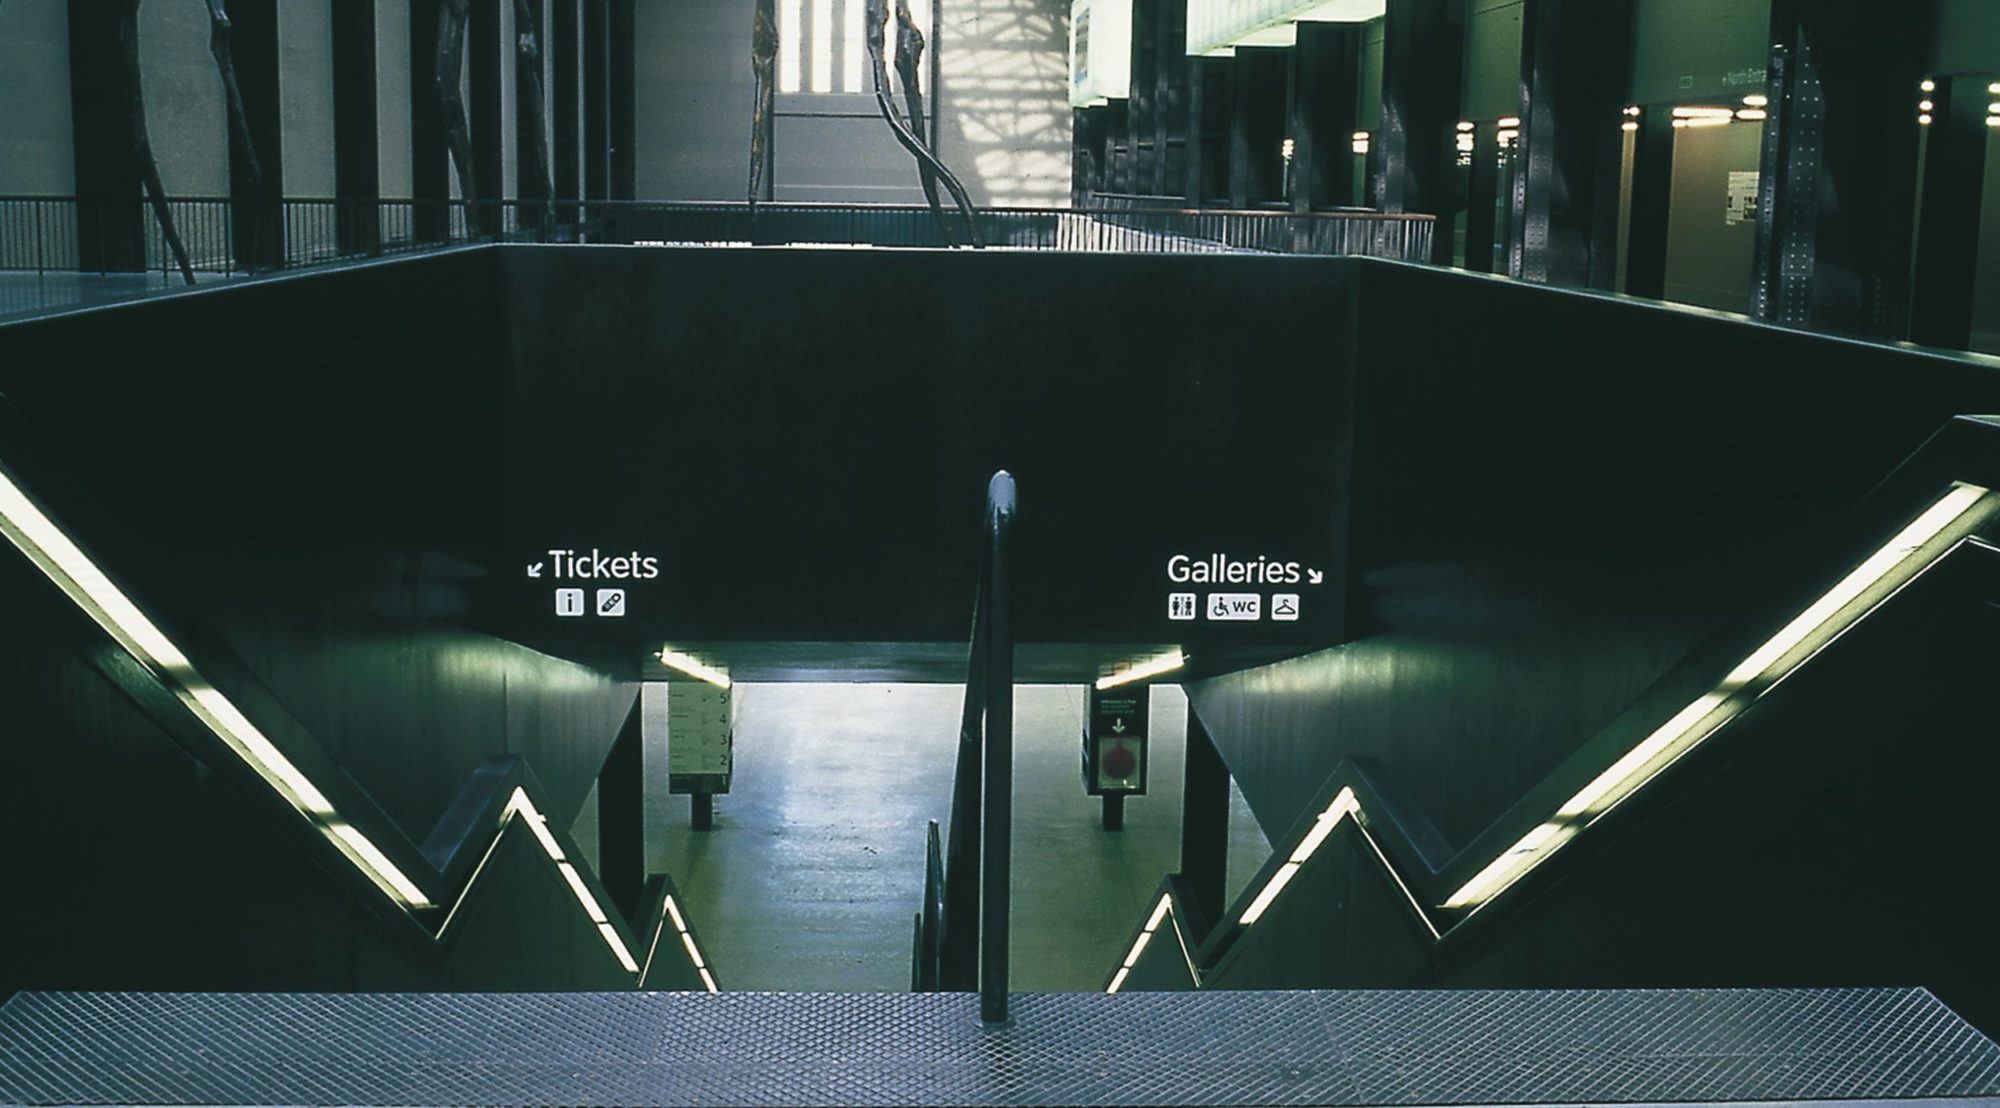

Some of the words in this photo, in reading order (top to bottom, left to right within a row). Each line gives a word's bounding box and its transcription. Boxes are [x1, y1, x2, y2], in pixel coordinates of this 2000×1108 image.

[548, 549, 659, 579] Tickets
[1167, 553, 1301, 584] Galleries
[1232, 601, 1257, 613] WC
[720, 693, 727, 705] 5
[719, 714, 727, 724] 4
[720, 735, 727, 746] 3
[720, 755, 727, 766] 2
